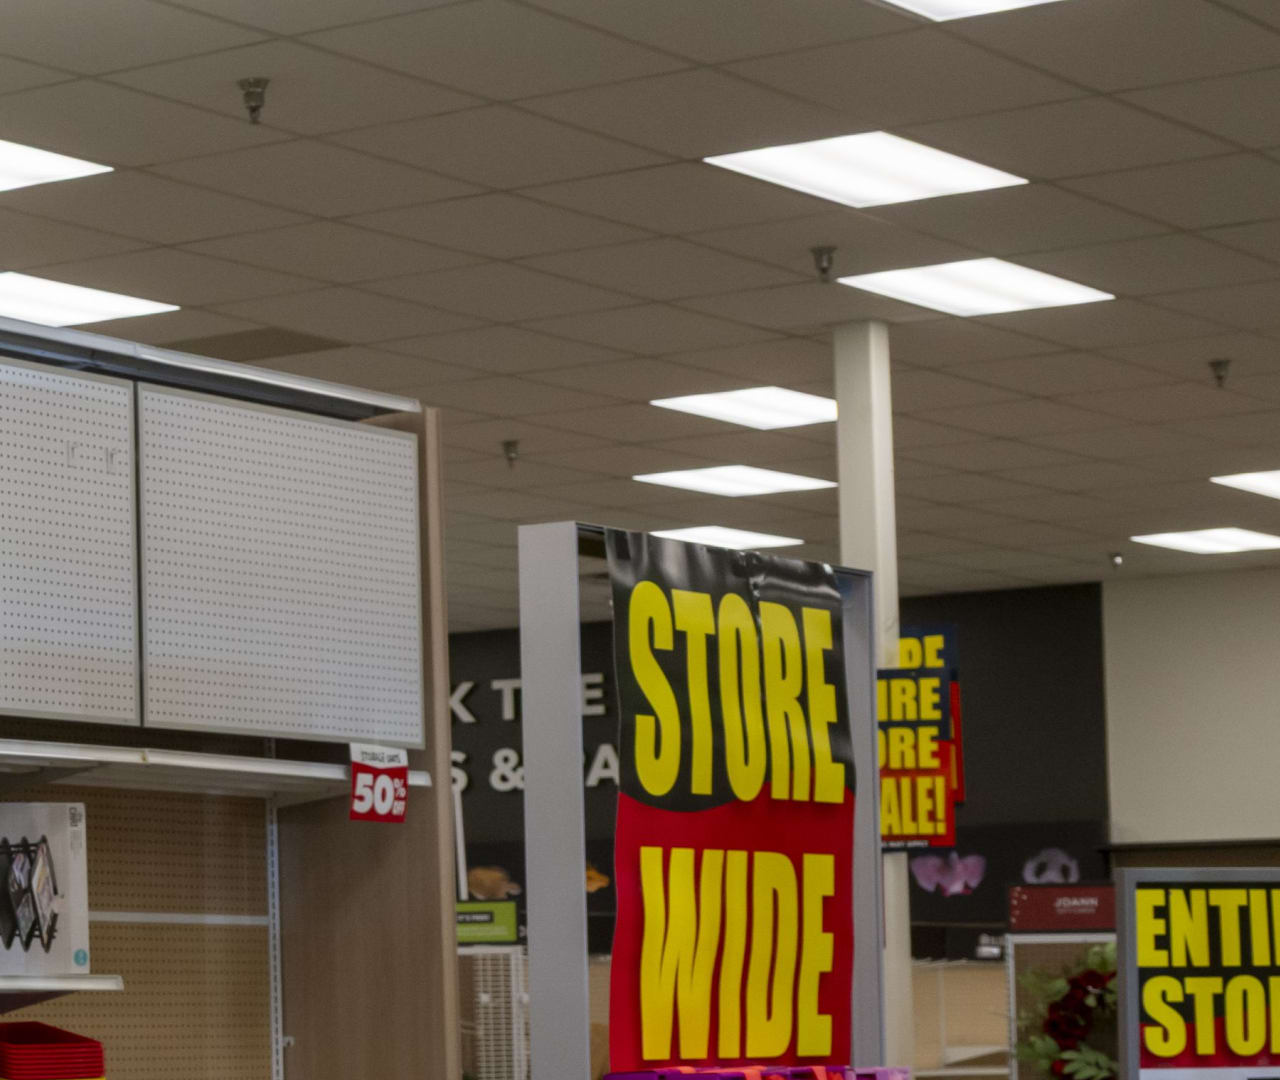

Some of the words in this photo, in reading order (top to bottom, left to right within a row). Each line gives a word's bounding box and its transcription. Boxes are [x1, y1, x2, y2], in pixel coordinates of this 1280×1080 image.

[898, 634, 944, 670] DE
[629, 580, 845, 804] STORE
[877, 677, 942, 721] IRE
[353, 772, 407, 815] 50%
[881, 776, 947, 835] ALE!
[640, 846, 836, 1060] WIDE
[1136, 888, 1280, 967] ENTI
[1142, 974, 1280, 1058] STO
